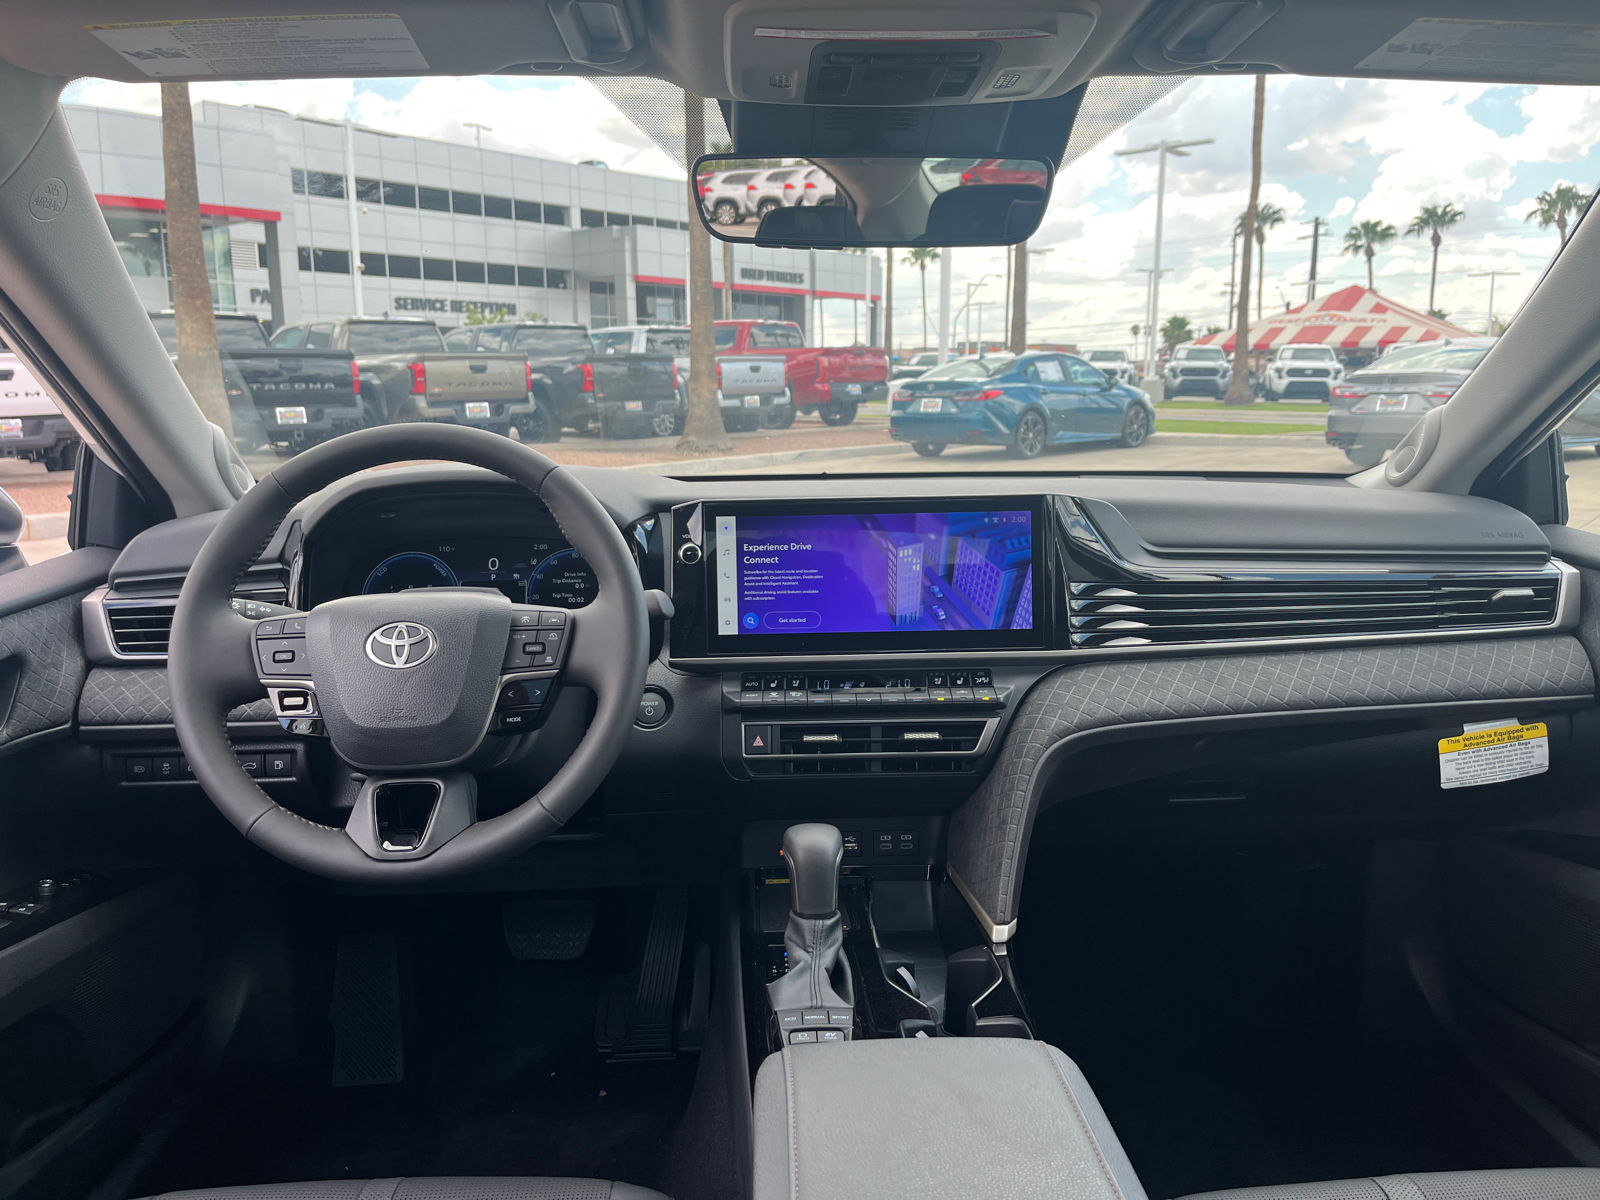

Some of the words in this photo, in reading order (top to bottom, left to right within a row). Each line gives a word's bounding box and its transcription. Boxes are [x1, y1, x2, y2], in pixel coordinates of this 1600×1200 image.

[45, 183, 61, 197] SRS
[32, 195, 62, 212] AIRBAG
[394, 297, 448, 312] SERVICE
[248, 382, 335, 390] TACOMA
[743, 542, 789, 553] Experience
[790, 542, 812, 551] Drive
[488, 557, 499, 571] 0
[743, 556, 779, 564] Connect
[377, 566, 388, 577] ECO
[433, 563, 448, 578] POWER
[1461, 734, 1486, 742] Vehicle
[1493, 727, 1524, 738] Equipped
[1525, 724, 1539, 732] with
[1463, 738, 1495, 748] Advanced
[1483, 744, 1508, 752] Advanced
